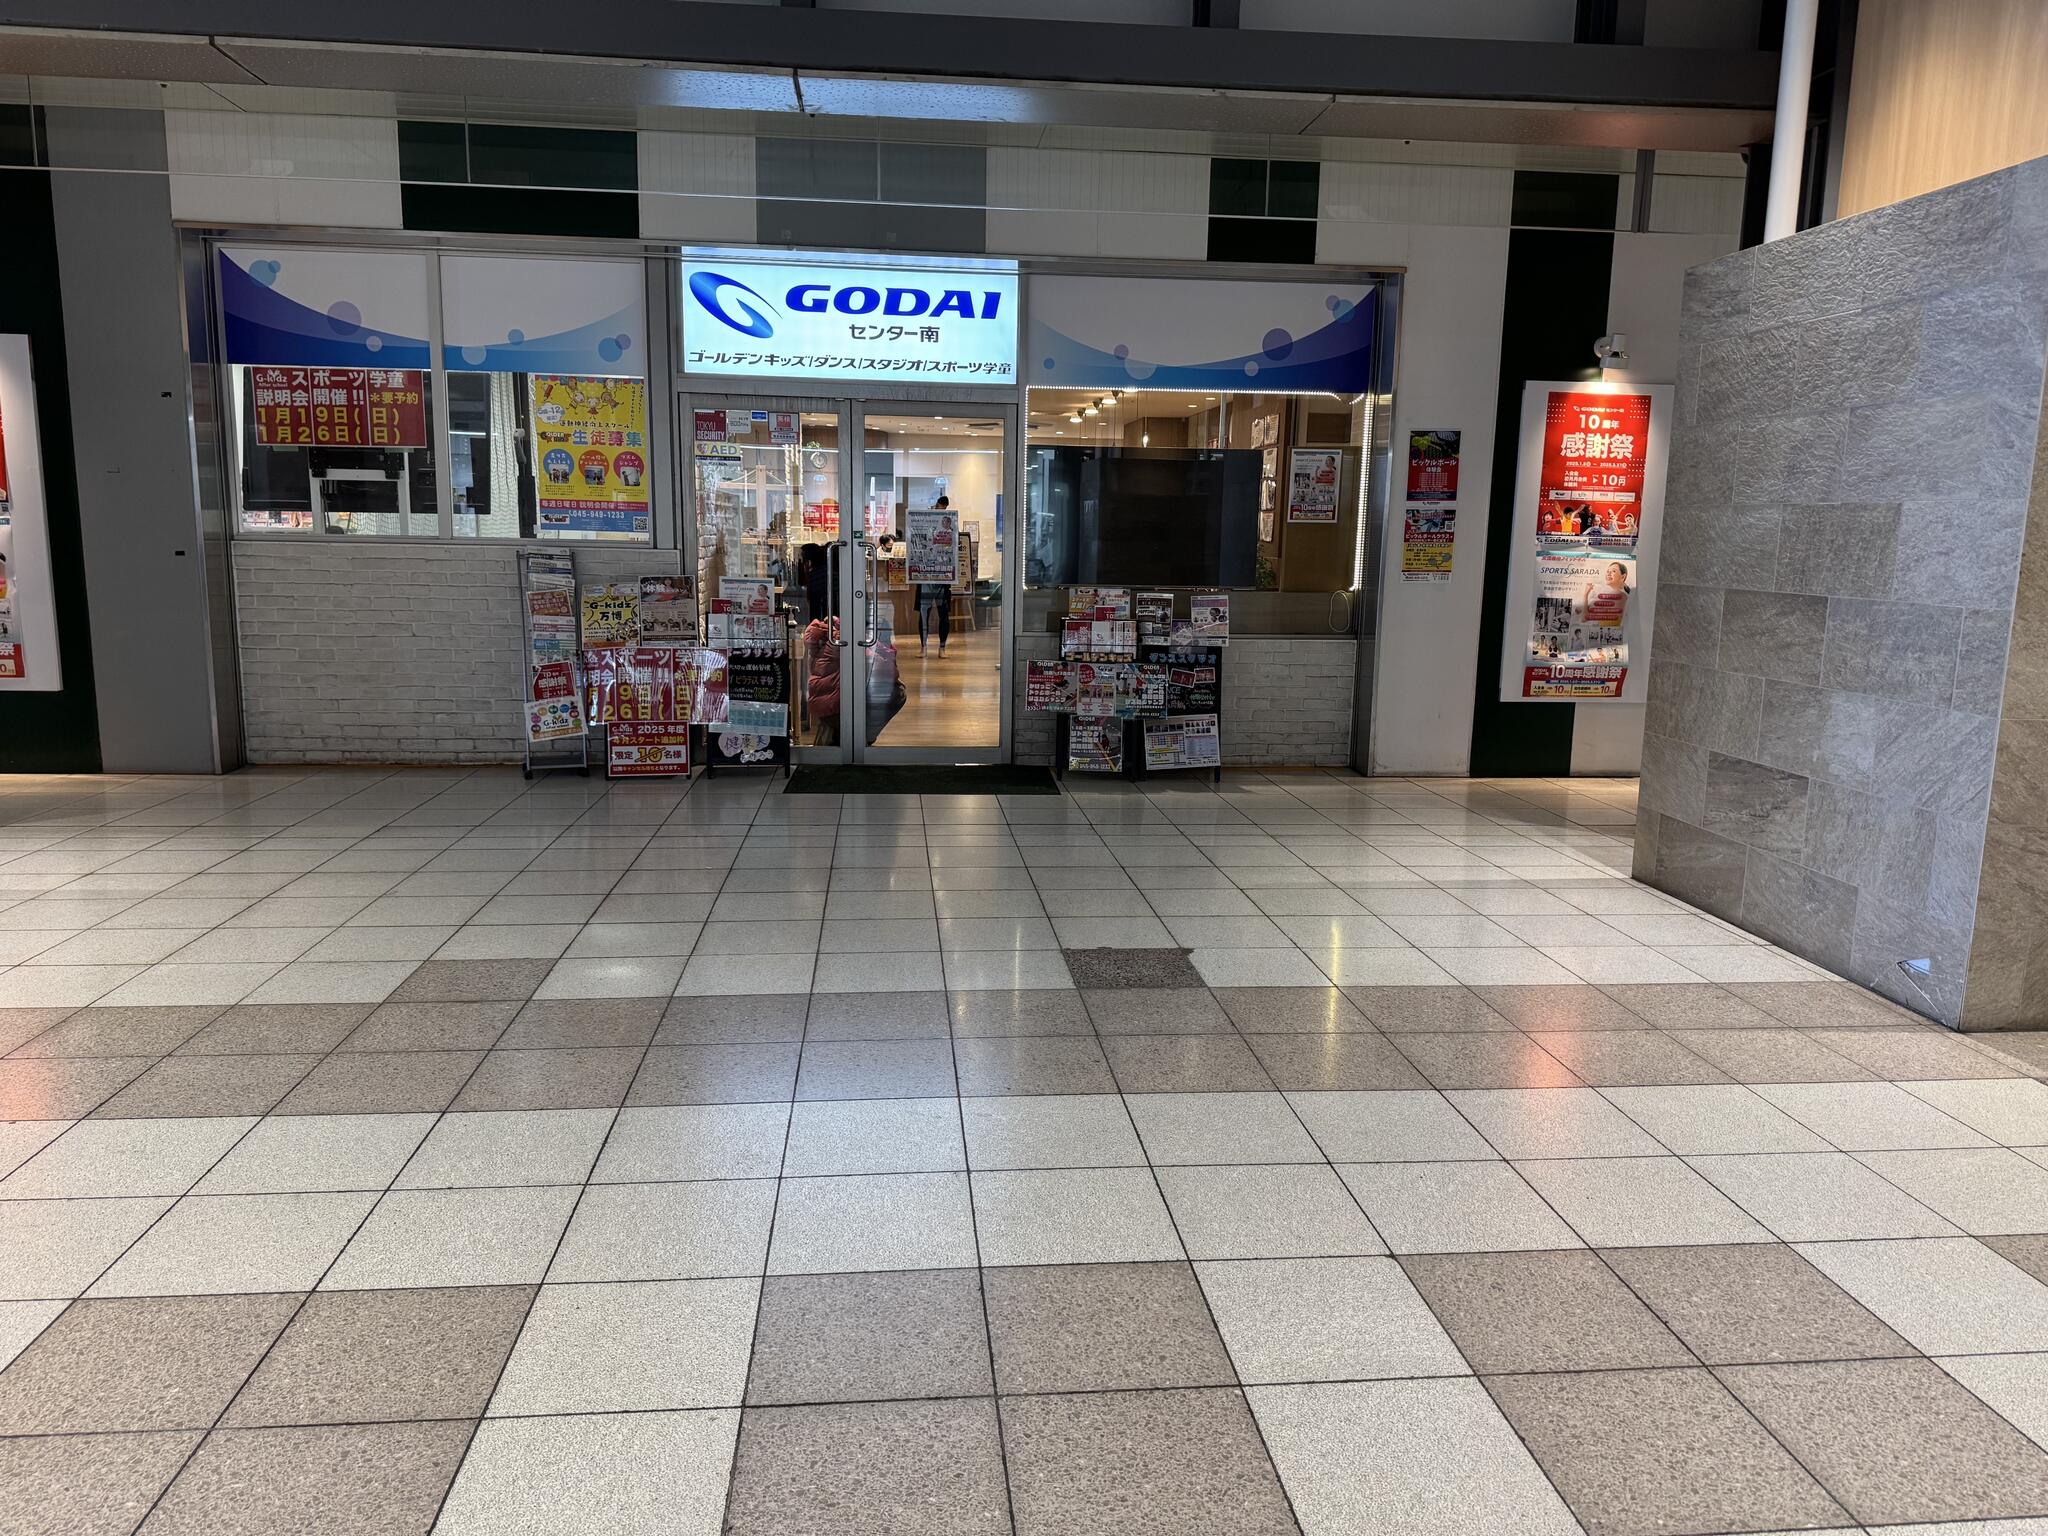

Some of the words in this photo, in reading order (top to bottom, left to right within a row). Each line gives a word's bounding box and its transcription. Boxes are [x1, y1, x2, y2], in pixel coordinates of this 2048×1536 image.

[785, 284, 1002, 319] GODAI
[849, 323, 940, 344] センター南
[291, 370, 405, 388] スポーツ学童
[696, 421, 716, 430] TOKYU
[572, 429, 642, 447] 生徒募集
[696, 430, 725, 440] SECURITY
[710, 445, 737, 455] AED
[1560, 432, 1634, 459] 感謝祭
[1540, 566, 1568, 575] SPORTS
[1570, 567, 1600, 576] SARADA
[589, 601, 632, 609] G-kidz
